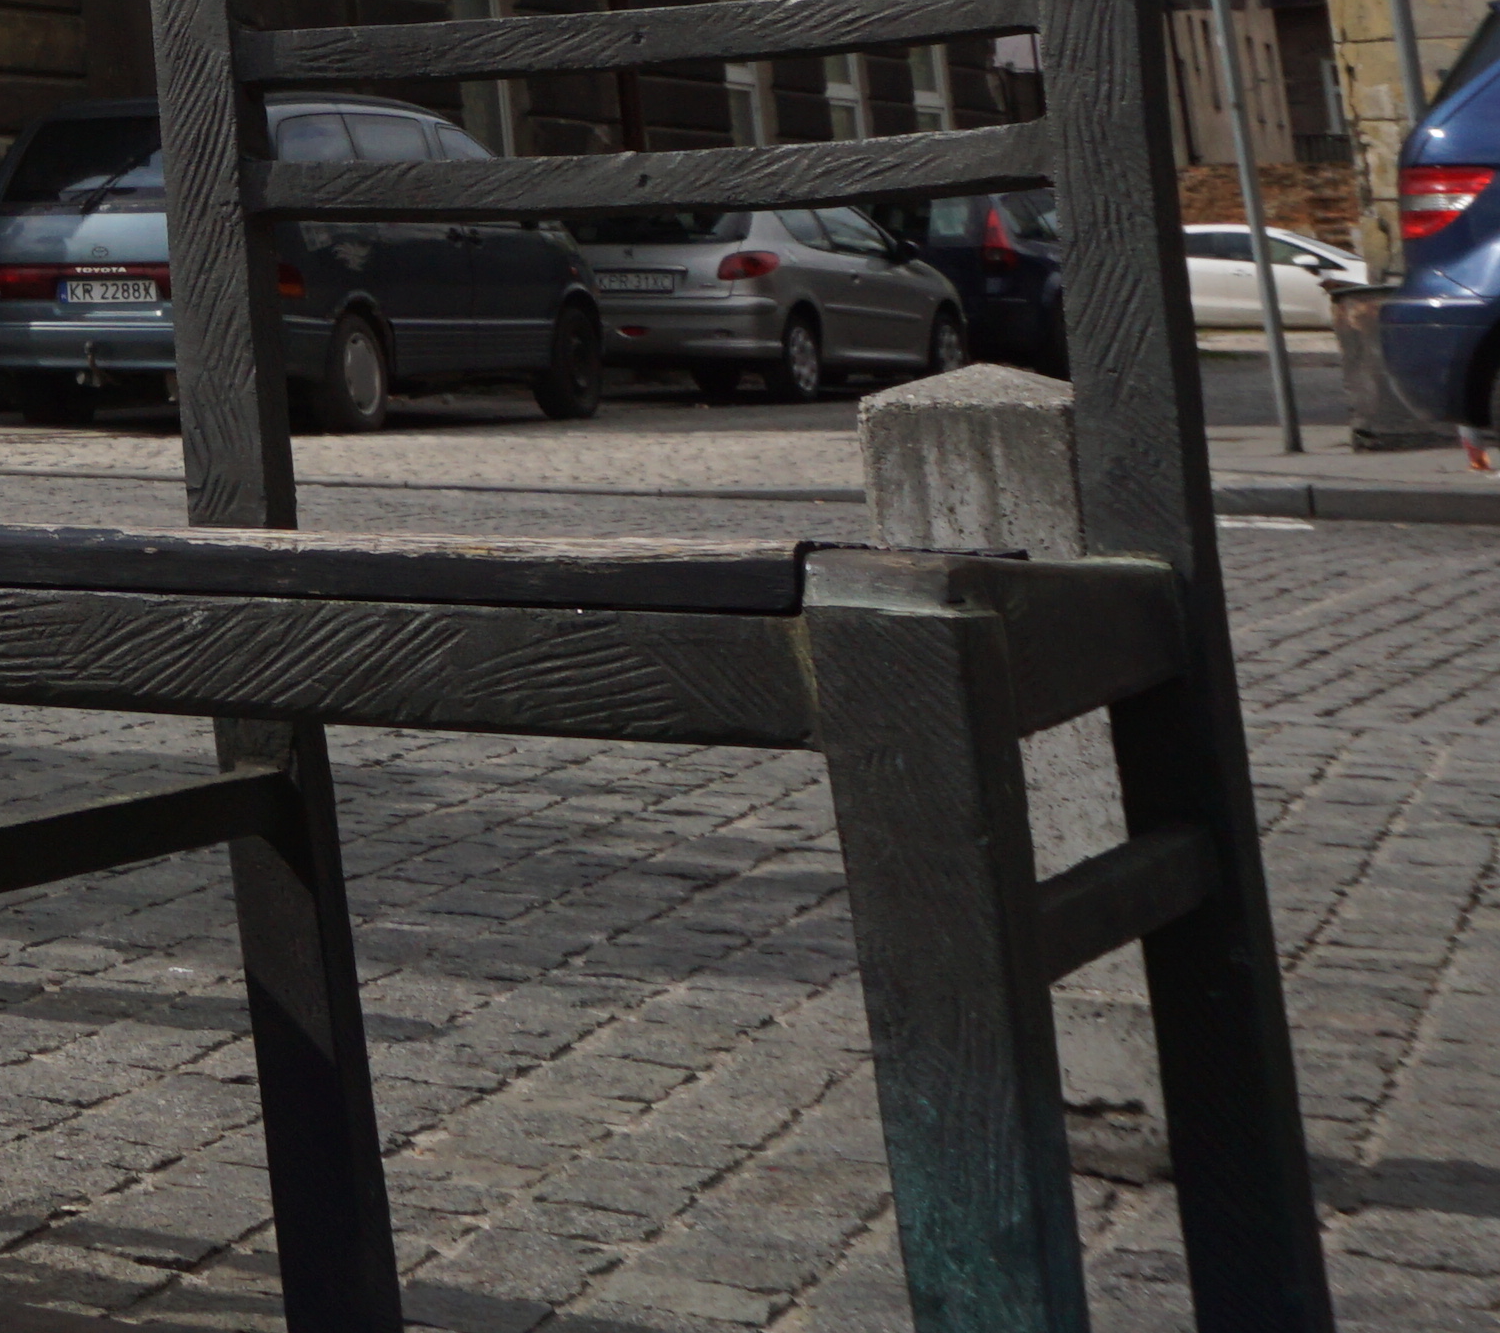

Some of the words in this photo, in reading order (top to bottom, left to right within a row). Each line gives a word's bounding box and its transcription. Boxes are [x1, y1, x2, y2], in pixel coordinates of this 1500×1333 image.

[75, 266, 127, 274] TOYOTA
[69, 283, 94, 301] KR
[100, 282, 154, 301] 2288X
